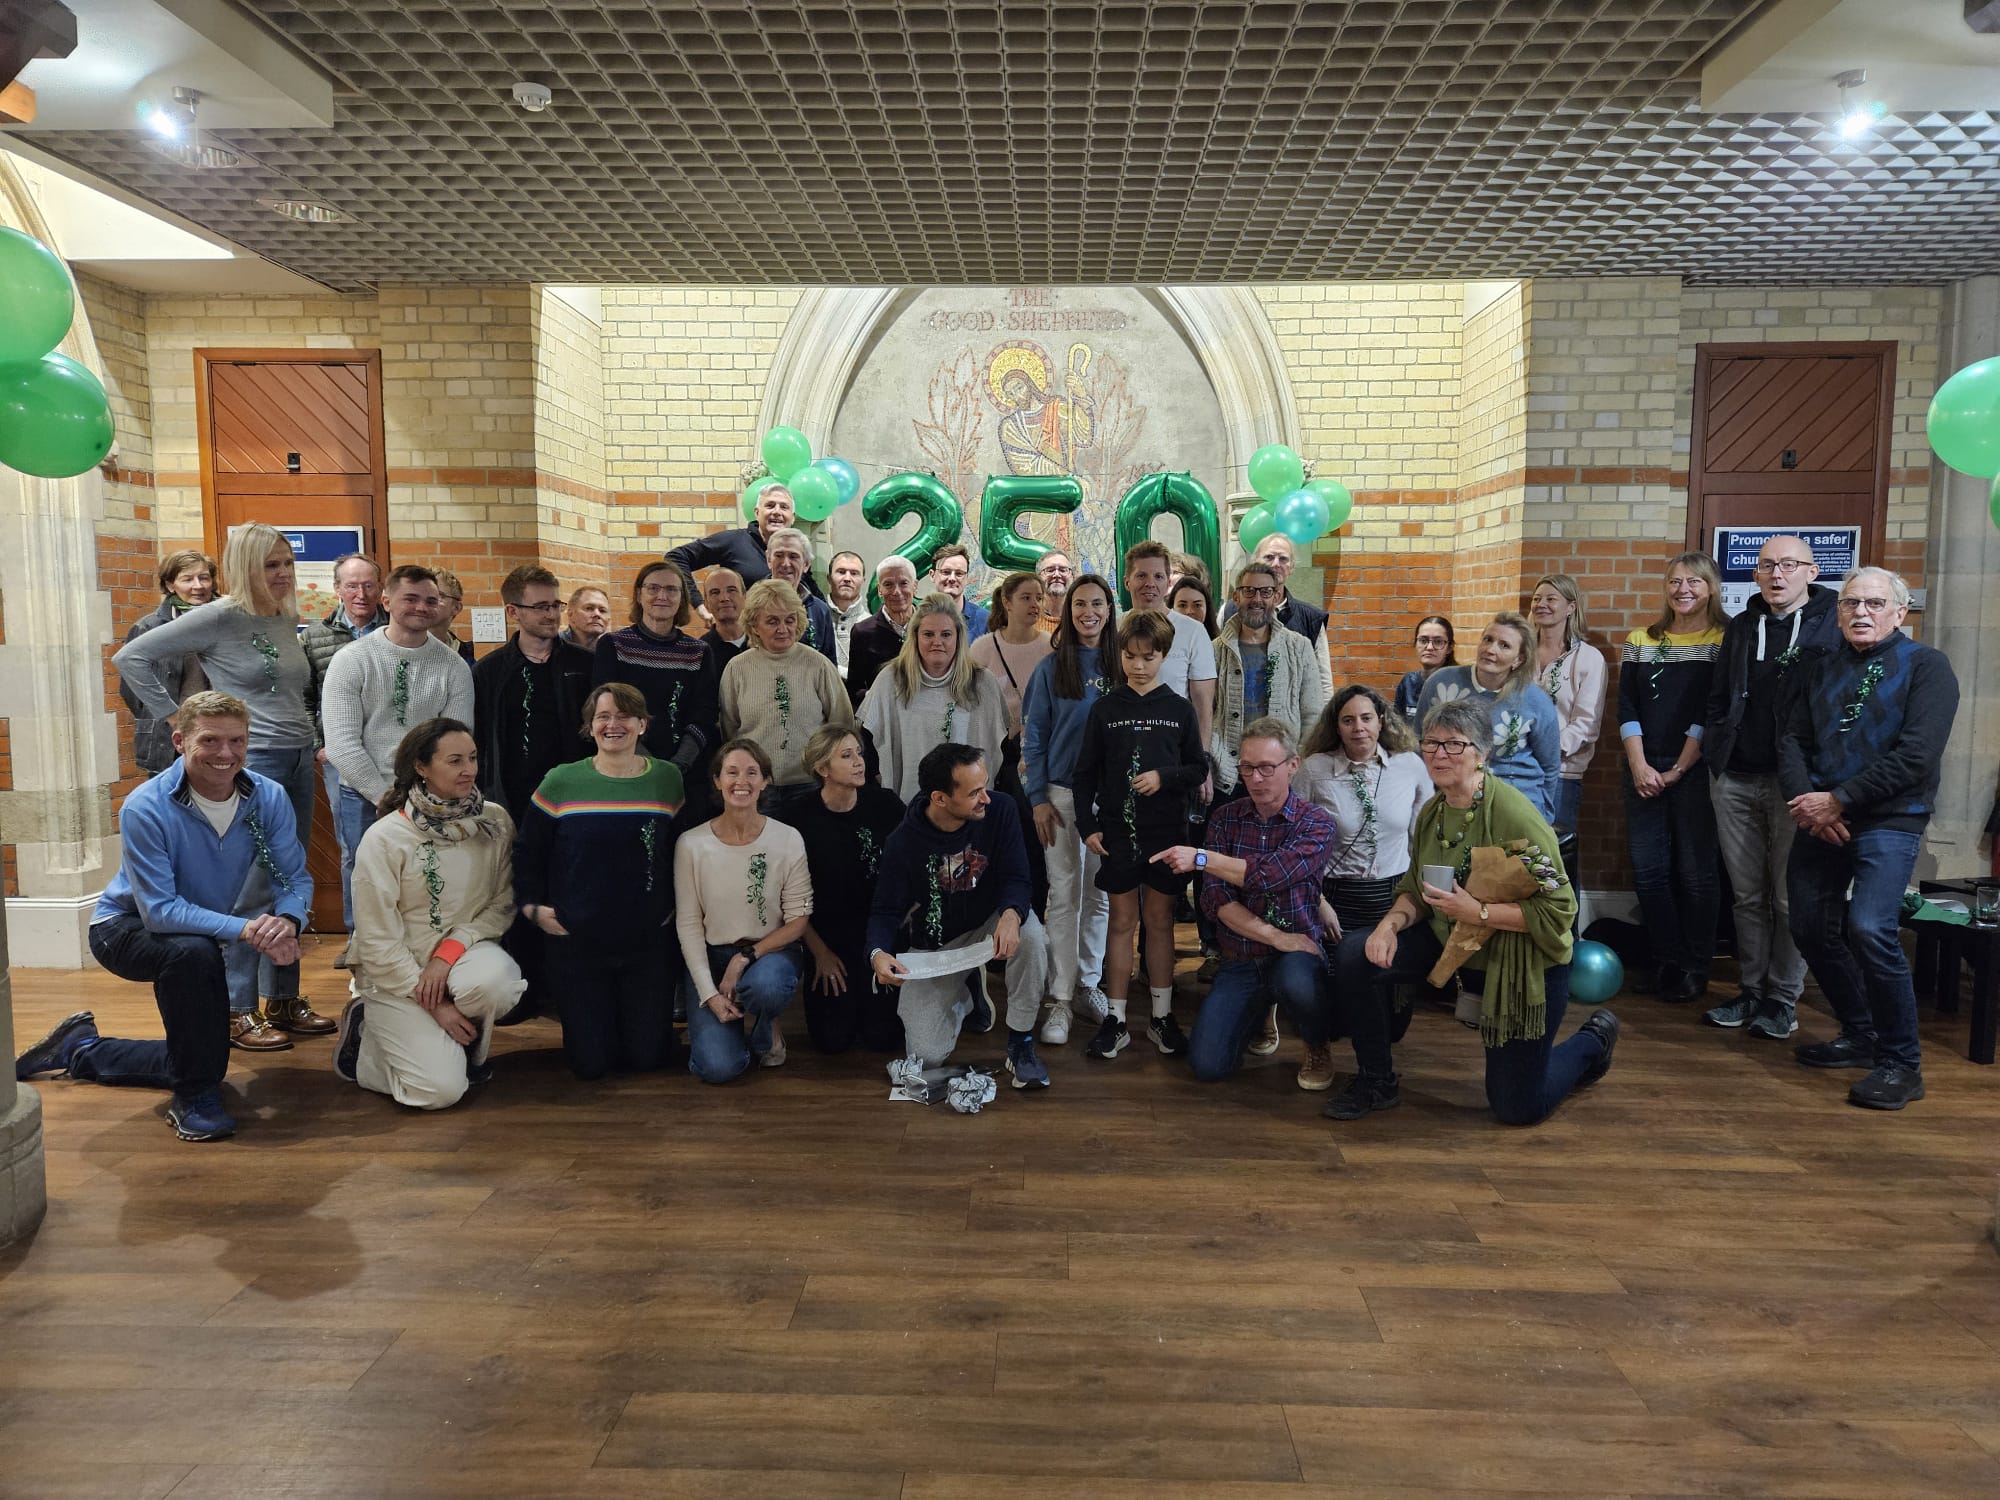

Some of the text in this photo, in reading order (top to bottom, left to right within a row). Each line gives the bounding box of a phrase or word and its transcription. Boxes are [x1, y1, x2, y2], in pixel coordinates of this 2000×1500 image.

[1009, 287, 1053, 307] THE
[929, 309, 1127, 332] GOOD SHEPHERD
[1814, 533, 1848, 545] safer
[1107, 719, 1179, 729] TOMMY HILFIGER
